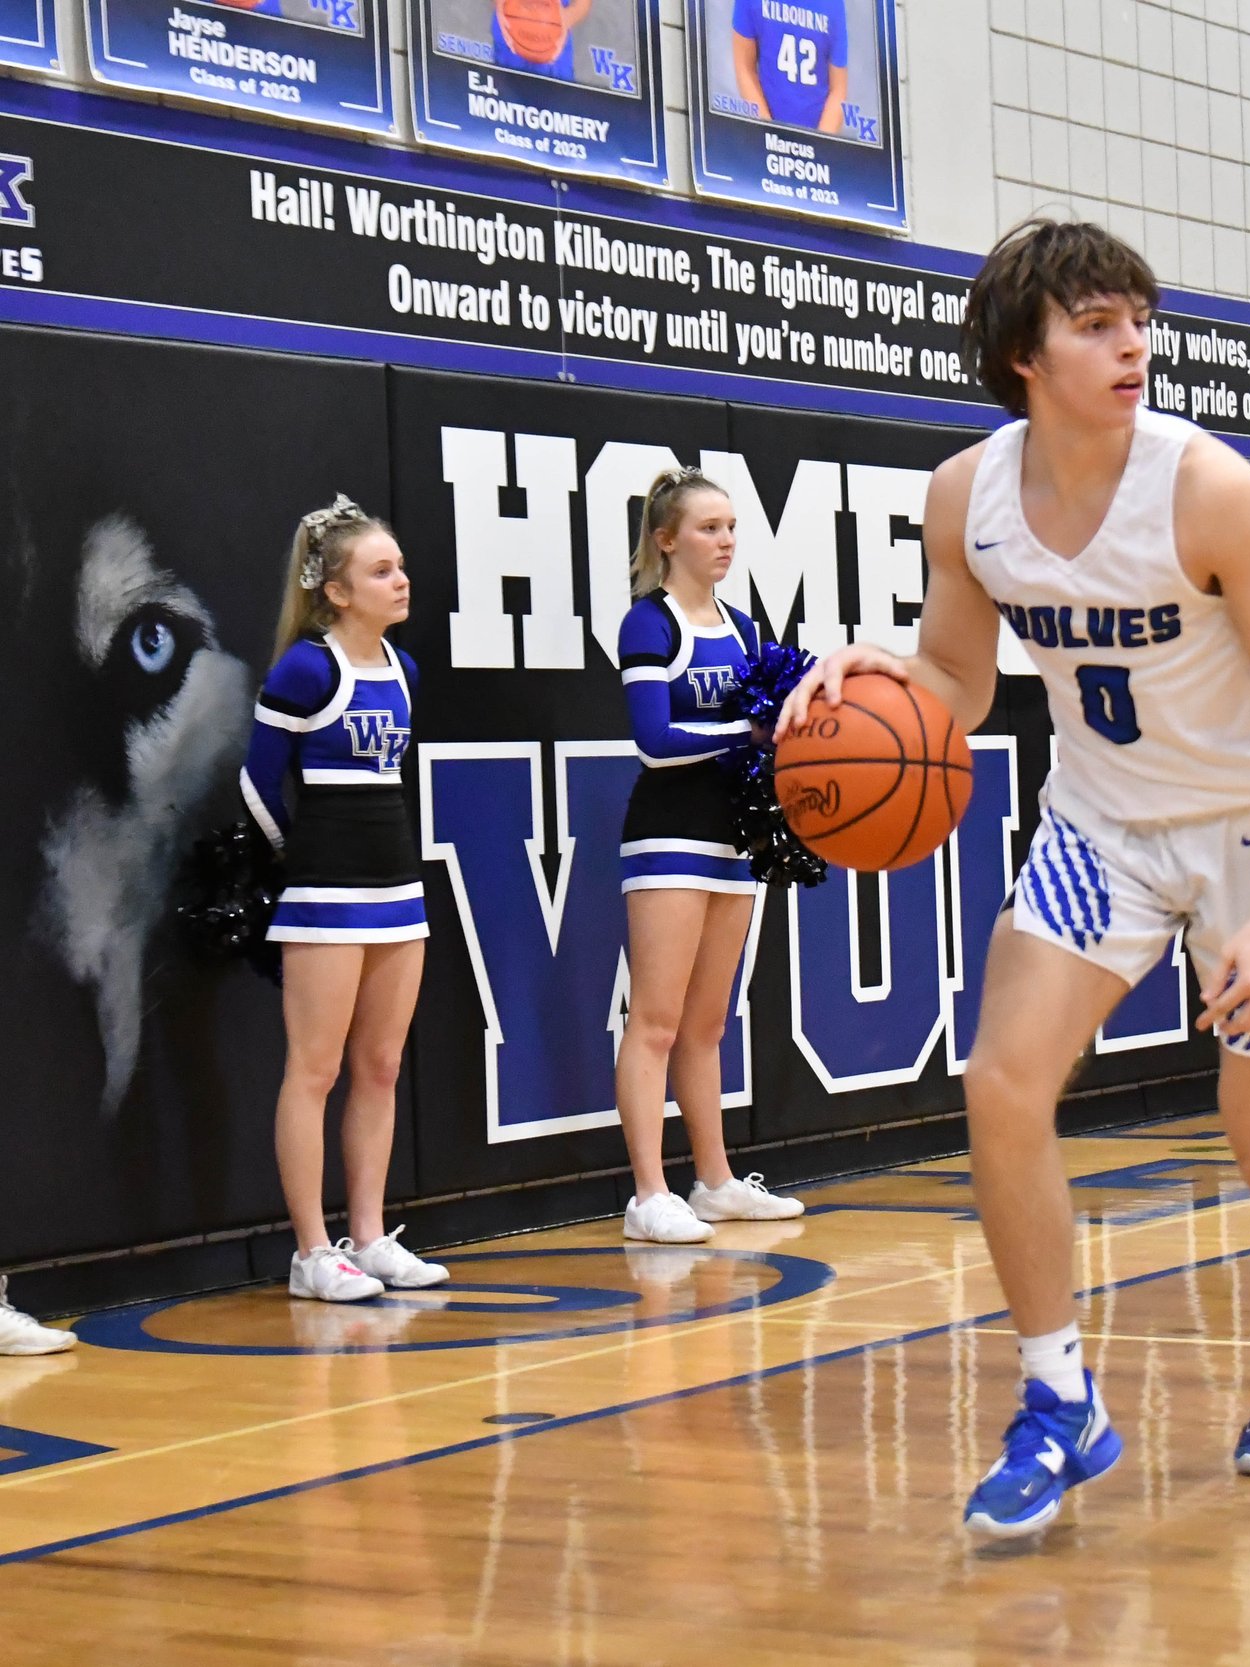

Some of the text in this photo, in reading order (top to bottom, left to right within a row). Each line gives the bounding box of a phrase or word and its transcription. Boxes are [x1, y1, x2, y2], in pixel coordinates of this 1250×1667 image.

[168, 7, 227, 38] Jayse
[761, 0, 829, 34] KILBOURNE
[168, 31, 317, 84] HENDERSON
[438, 33, 495, 63] SENIOR
[777, 33, 818, 86] 42
[189, 66, 302, 103] Class of 2023
[467, 70, 499, 96] E.J.
[590, 45, 636, 92] WK
[467, 93, 610, 143] MONTGOMERY
[713, 93, 760, 118] SENIOR
[841, 102, 878, 142] WK
[494, 127, 588, 161] Class of 2023
[765, 132, 815, 160] Marcus
[766, 153, 830, 186] GIPSON
[761, 178, 839, 205] Class of 2023
[250, 170, 335, 231] Hail!
[345, 186, 545, 265] Worthington
[553, 221, 700, 294] Kilbourne,
[706, 246, 756, 295] The
[762, 256, 859, 319] fighting
[866, 281, 925, 325] royal
[388, 264, 511, 326] Onward
[518, 285, 551, 332] to
[557, 290, 658, 354] victory
[666, 310, 729, 354] until
[735, 320, 816, 366] you're
[823, 333, 913, 377] number
[919, 349, 969, 385] one.
[1154, 373, 1186, 412] the
[1190, 380, 1238, 421] pride
[441, 426, 935, 670] HOME
[1074, 664, 1142, 745] 0
[342, 710, 411, 774] WK
